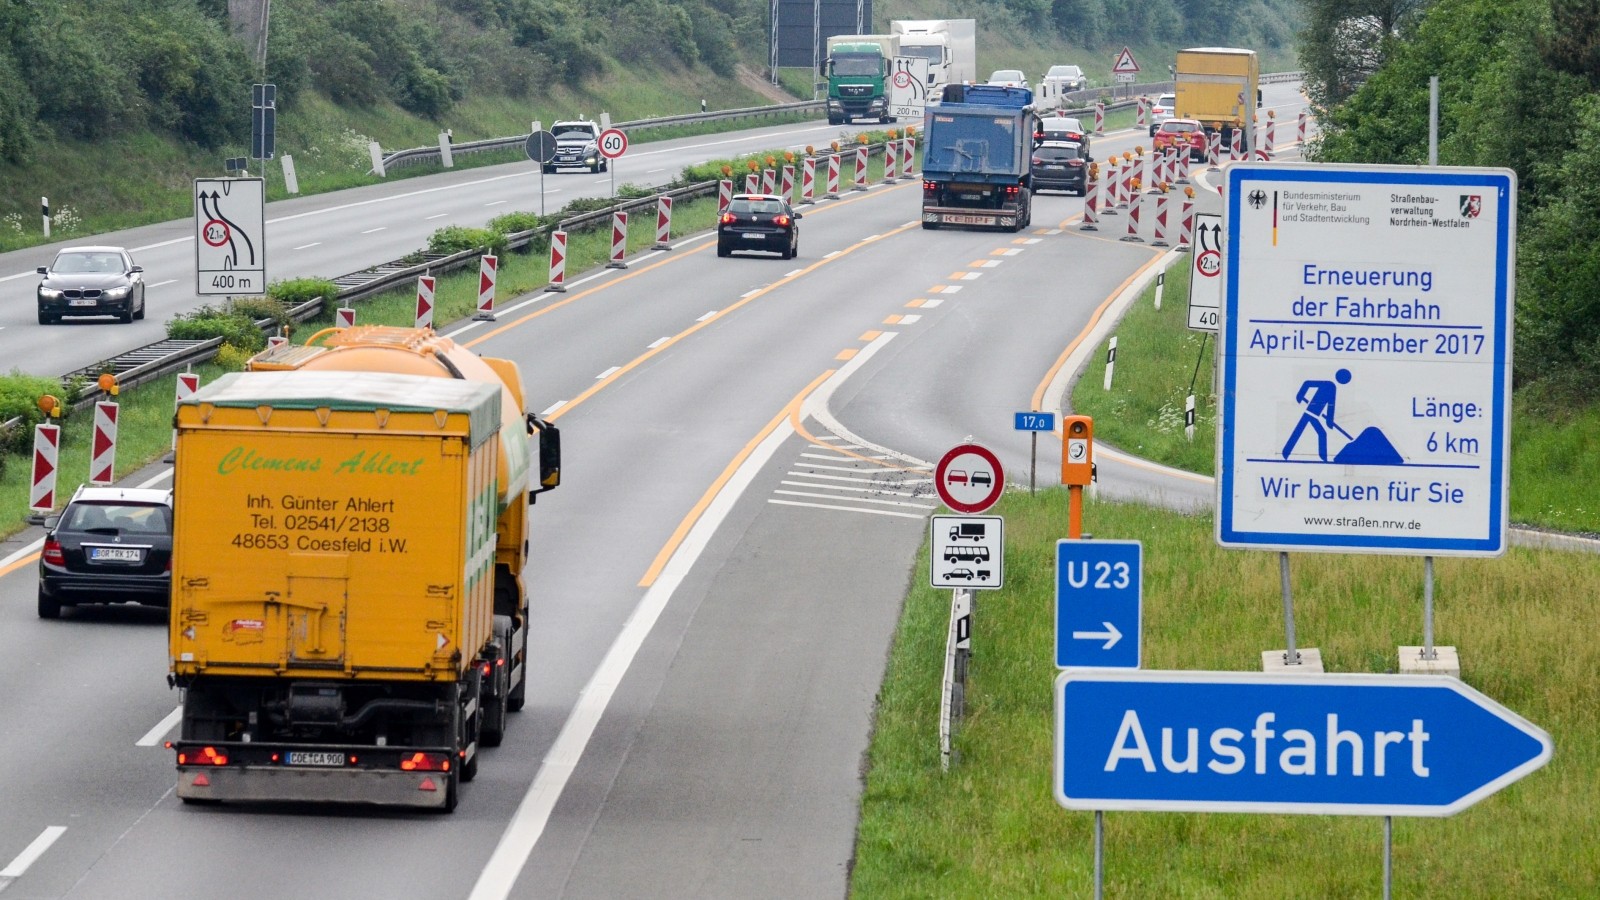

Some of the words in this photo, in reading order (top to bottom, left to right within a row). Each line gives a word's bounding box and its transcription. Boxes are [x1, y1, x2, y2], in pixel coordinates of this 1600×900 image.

[605, 137, 620, 149] 60
[1283, 190, 1361, 201] Bundesministerium
[1390, 194, 1439, 204] Straßenbau-
[1282, 202, 1294, 211] für
[1296, 202, 1329, 212] Verkehr,
[1330, 203, 1347, 212] Bau
[1390, 206, 1434, 218] verwaltung
[944, 216, 995, 225] KEMPF
[1282, 214, 1298, 222] und
[1299, 213, 1370, 226] Stadtentwicklung
[1389, 217, 1470, 229] Nordrhein-Westfalen
[212, 275, 235, 289] 400
[239, 278, 251, 288] m
[1303, 264, 1433, 292] Erneuerung
[1292, 296, 1329, 317] der
[1335, 296, 1441, 321] Fahrbahn
[1249, 328, 1428, 355] April-Dezember
[1434, 333, 1485, 356] 2017
[1411, 397, 1483, 424] Länge:
[1426, 431, 1439, 453] 6
[1446, 431, 1480, 454] km
[217, 446, 322, 477] Clemens
[334, 449, 425, 477] Ahlert
[1260, 476, 1301, 499] Wir
[1308, 478, 1380, 502] bauen
[1387, 480, 1422, 503] für
[1427, 481, 1465, 504] Sie
[246, 493, 274, 510] Inh.
[281, 494, 339, 512] Günter
[345, 496, 395, 513] Ahlert
[251, 513, 277, 530] Tel.
[284, 515, 390, 534] 02541/2138
[1303, 515, 1422, 531] www.straßen.nrw.de
[231, 533, 289, 550] 48653
[296, 534, 371, 553] Coesfeld
[126, 550, 139, 559] 174
[1103, 709, 1431, 778] Ausfahrt
[326, 754, 343, 764] 900
